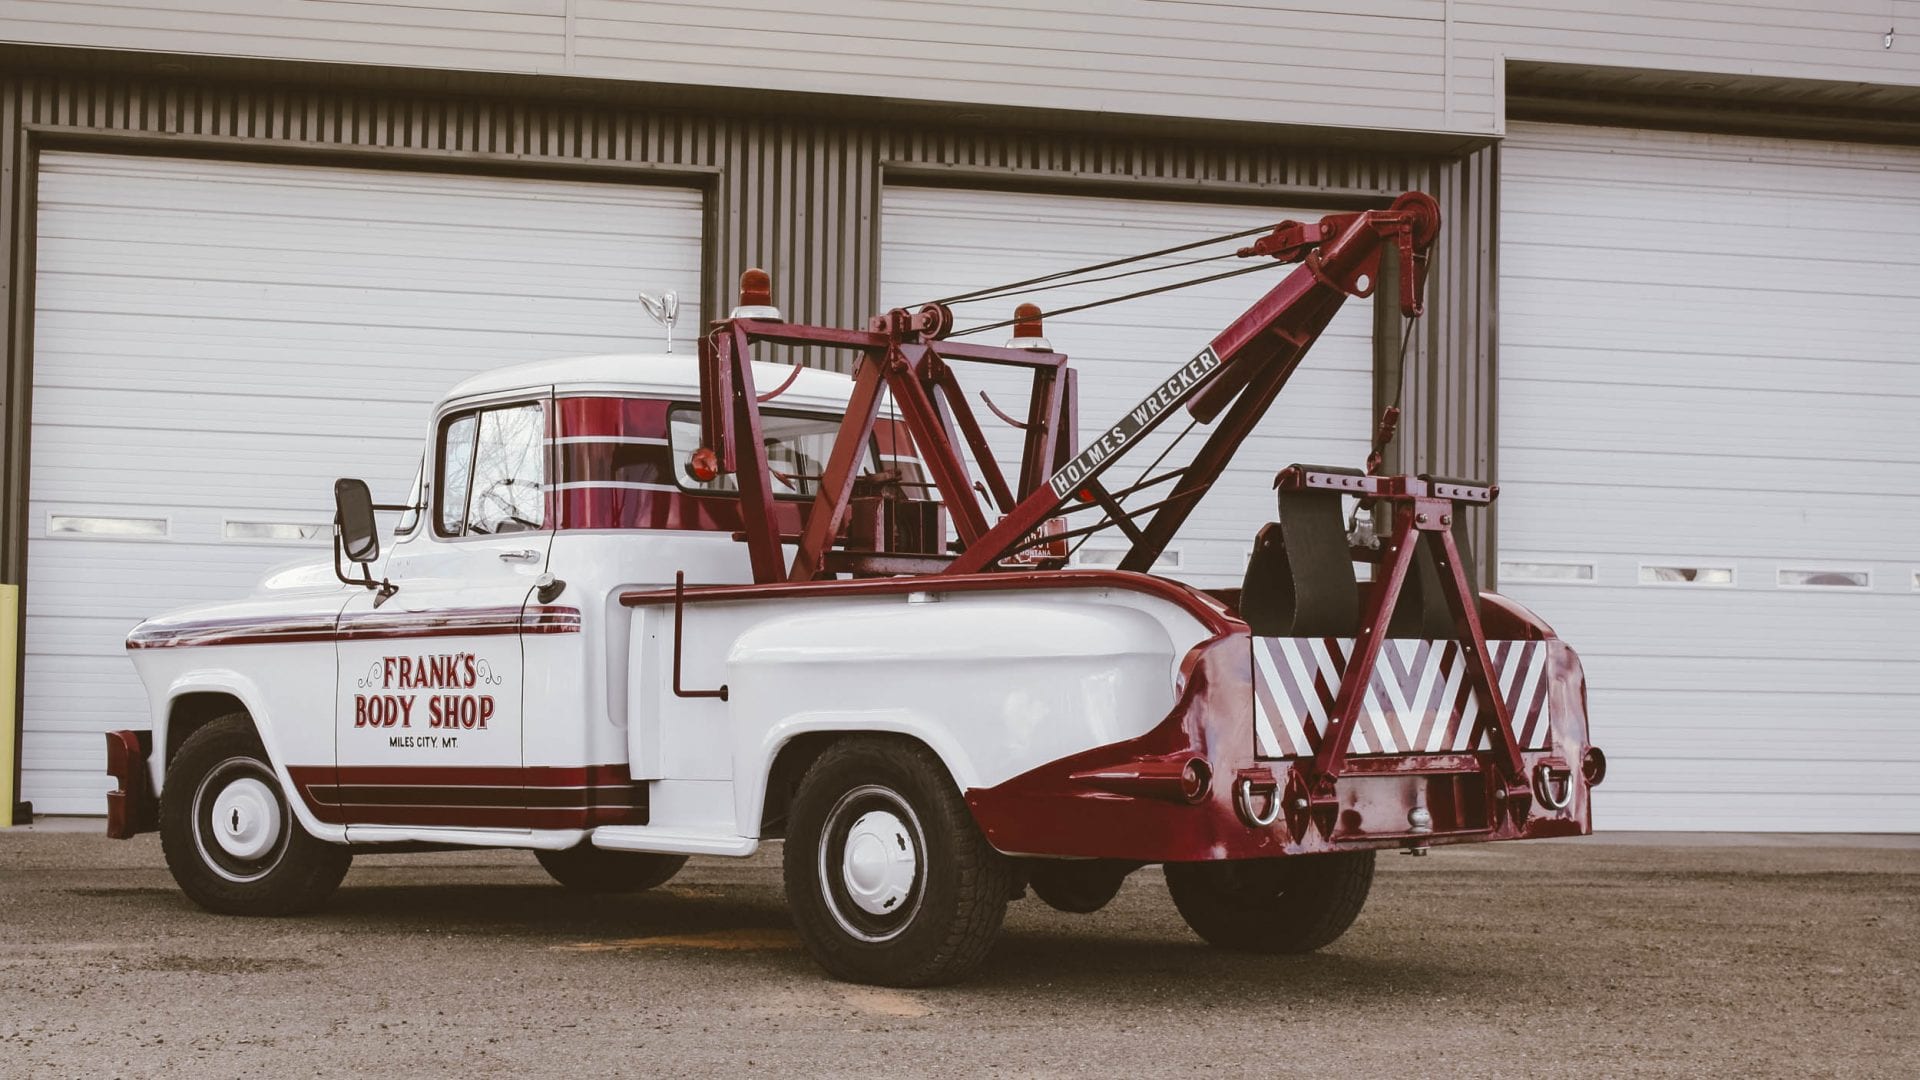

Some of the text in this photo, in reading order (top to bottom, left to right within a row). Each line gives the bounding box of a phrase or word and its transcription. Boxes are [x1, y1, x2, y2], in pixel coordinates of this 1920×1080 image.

[1055, 352, 1215, 494] HOLMES WRECKER
[382, 652, 476, 689] FRANK'S
[354, 694, 495, 730] BODY SHOP
[389, 736, 414, 748] MILES
